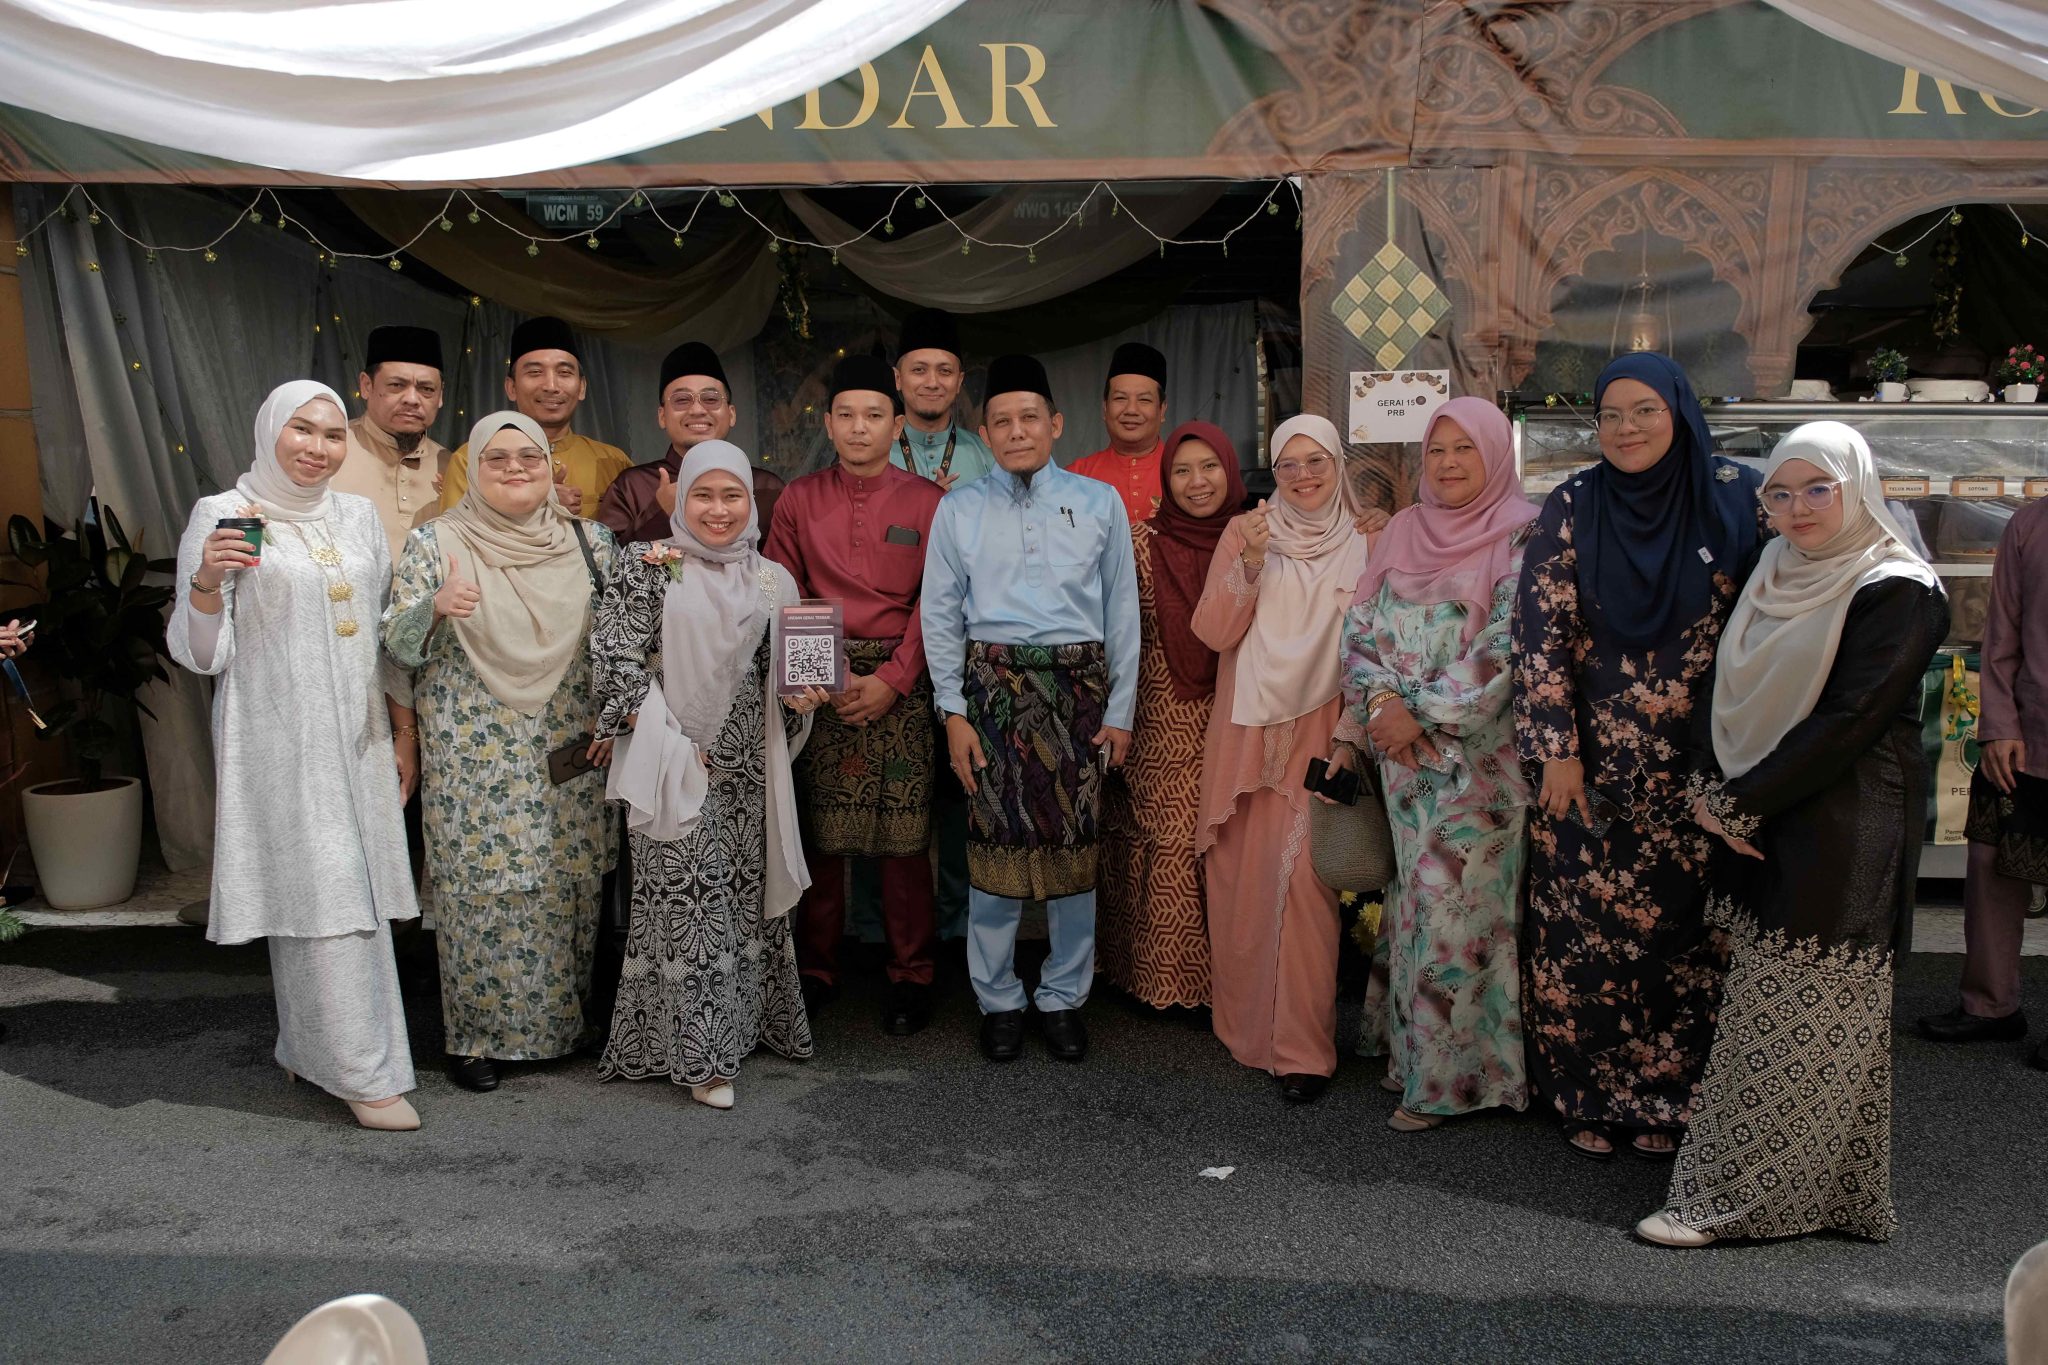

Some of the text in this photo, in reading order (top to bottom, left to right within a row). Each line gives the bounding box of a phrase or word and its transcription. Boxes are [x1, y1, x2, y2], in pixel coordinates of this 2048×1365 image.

[543, 204, 604, 221] WCM 59
[1377, 399, 1404, 407] GERAI
[1387, 409, 1405, 417] PRB
